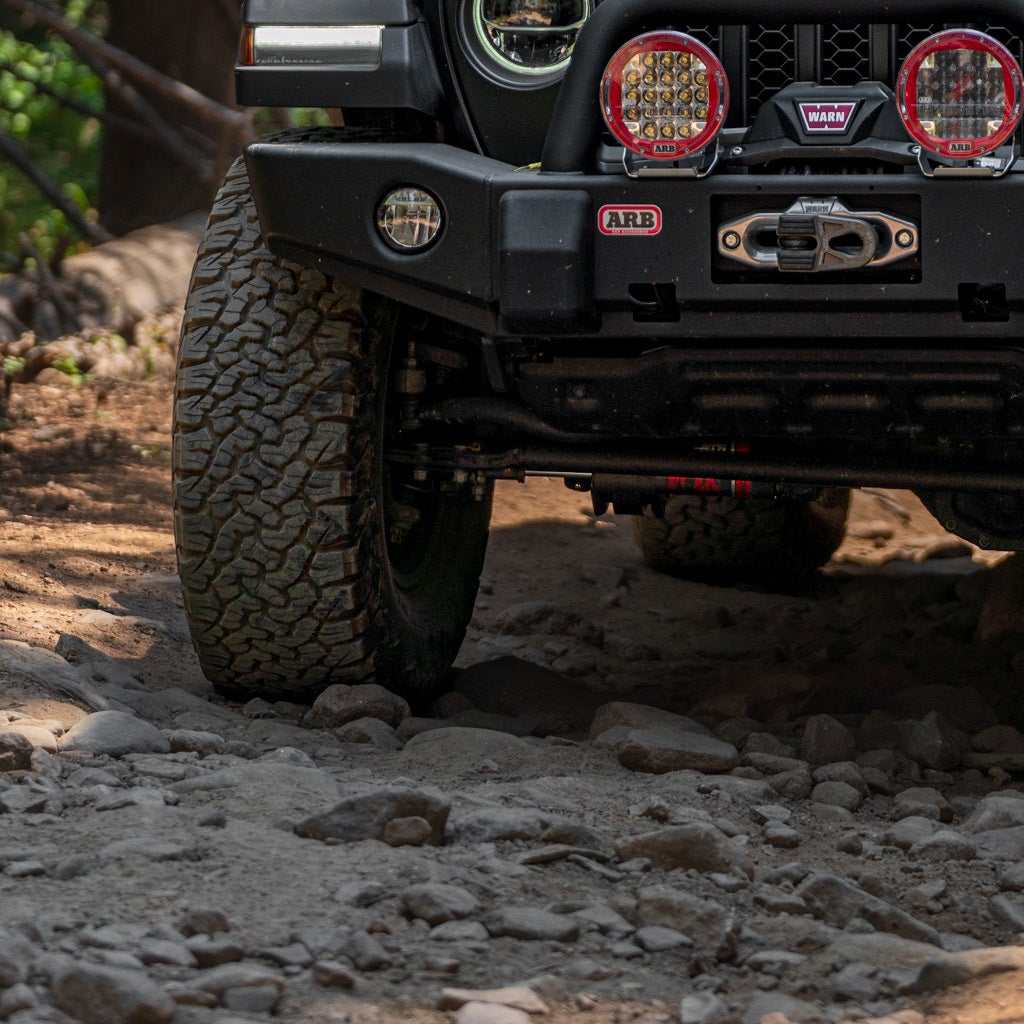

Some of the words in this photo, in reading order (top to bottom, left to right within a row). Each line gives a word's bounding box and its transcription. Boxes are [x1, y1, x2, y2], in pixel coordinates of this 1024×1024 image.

[808, 111, 845, 122] WARN
[654, 145, 676, 153] ARB
[950, 143, 971, 152] ARB
[605, 211, 655, 229] ARB
